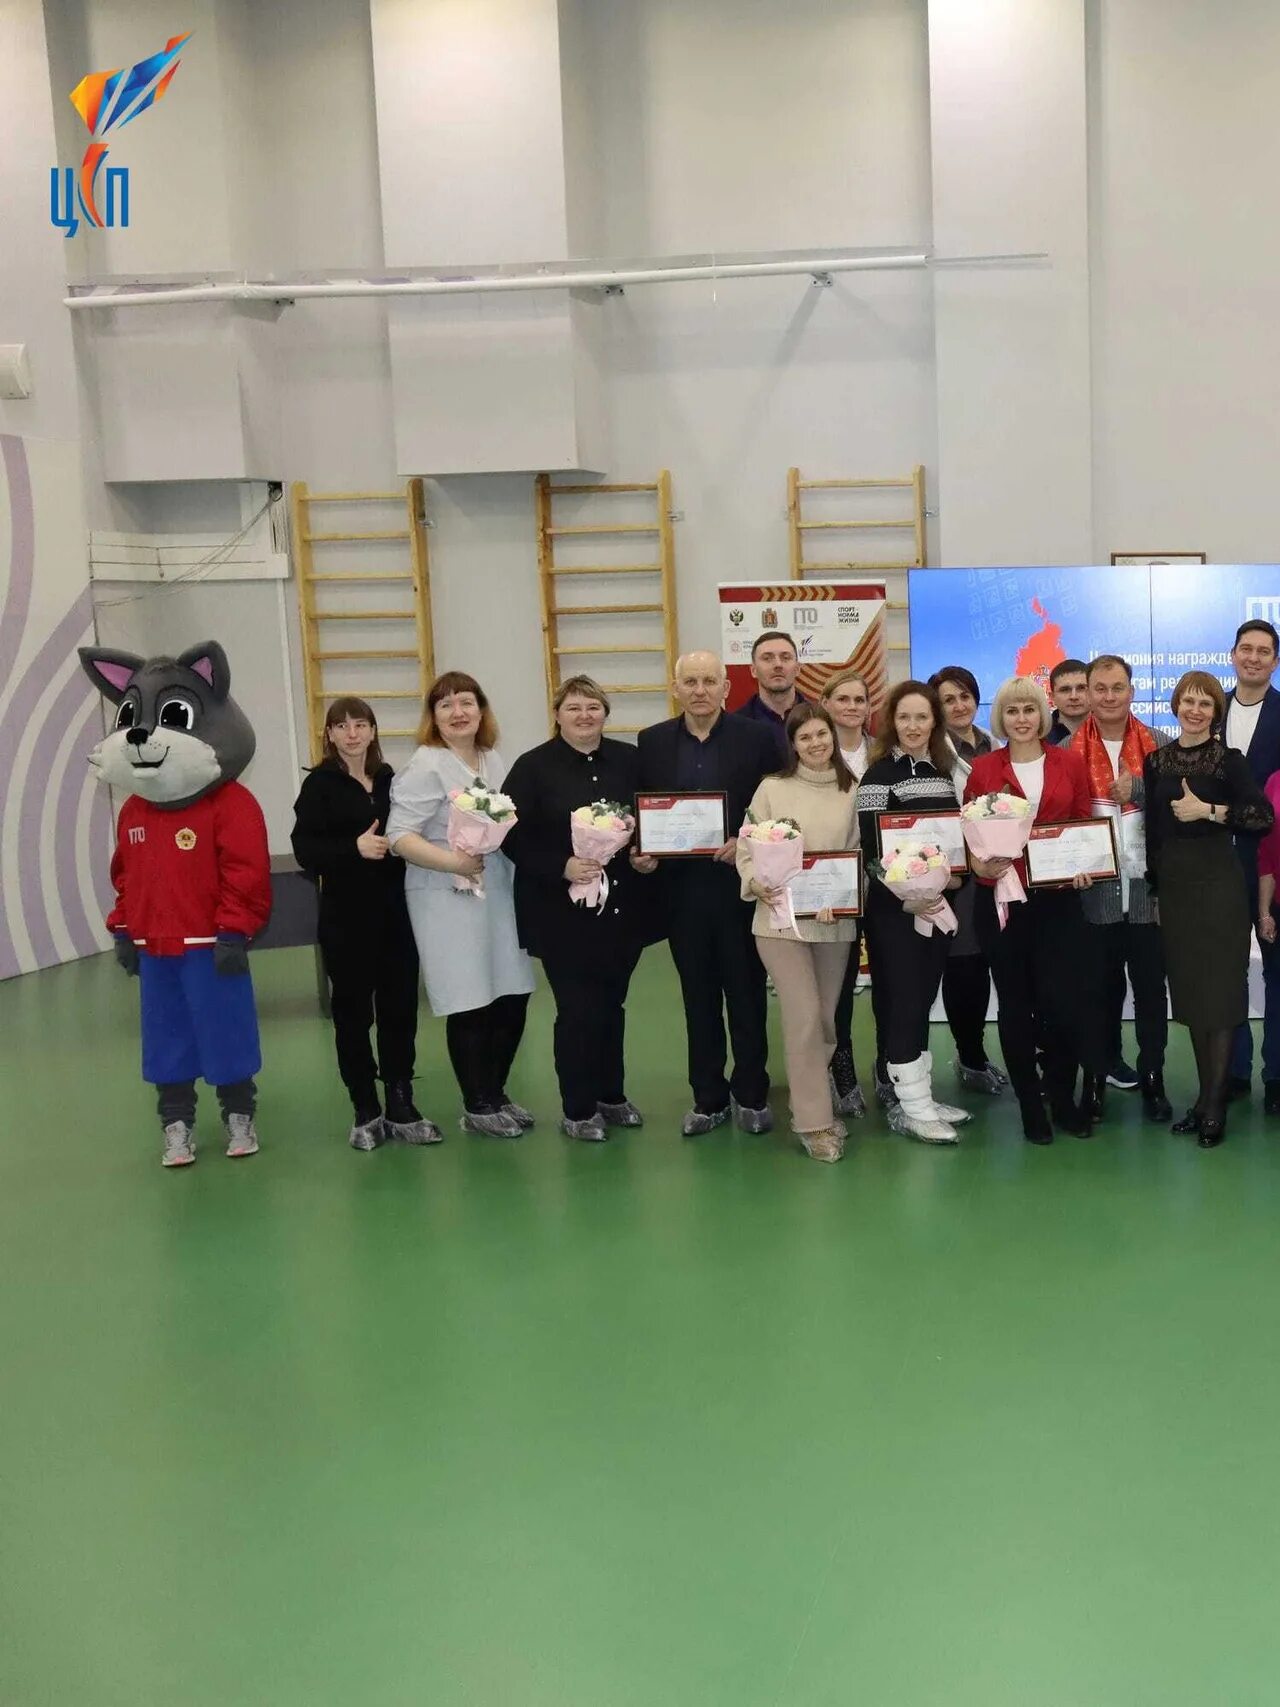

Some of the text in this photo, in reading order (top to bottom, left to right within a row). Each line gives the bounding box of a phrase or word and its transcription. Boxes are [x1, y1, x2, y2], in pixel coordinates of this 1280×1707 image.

[793, 607, 819, 625] ГТО
[1089, 650, 1233, 668] Цмония награжде
